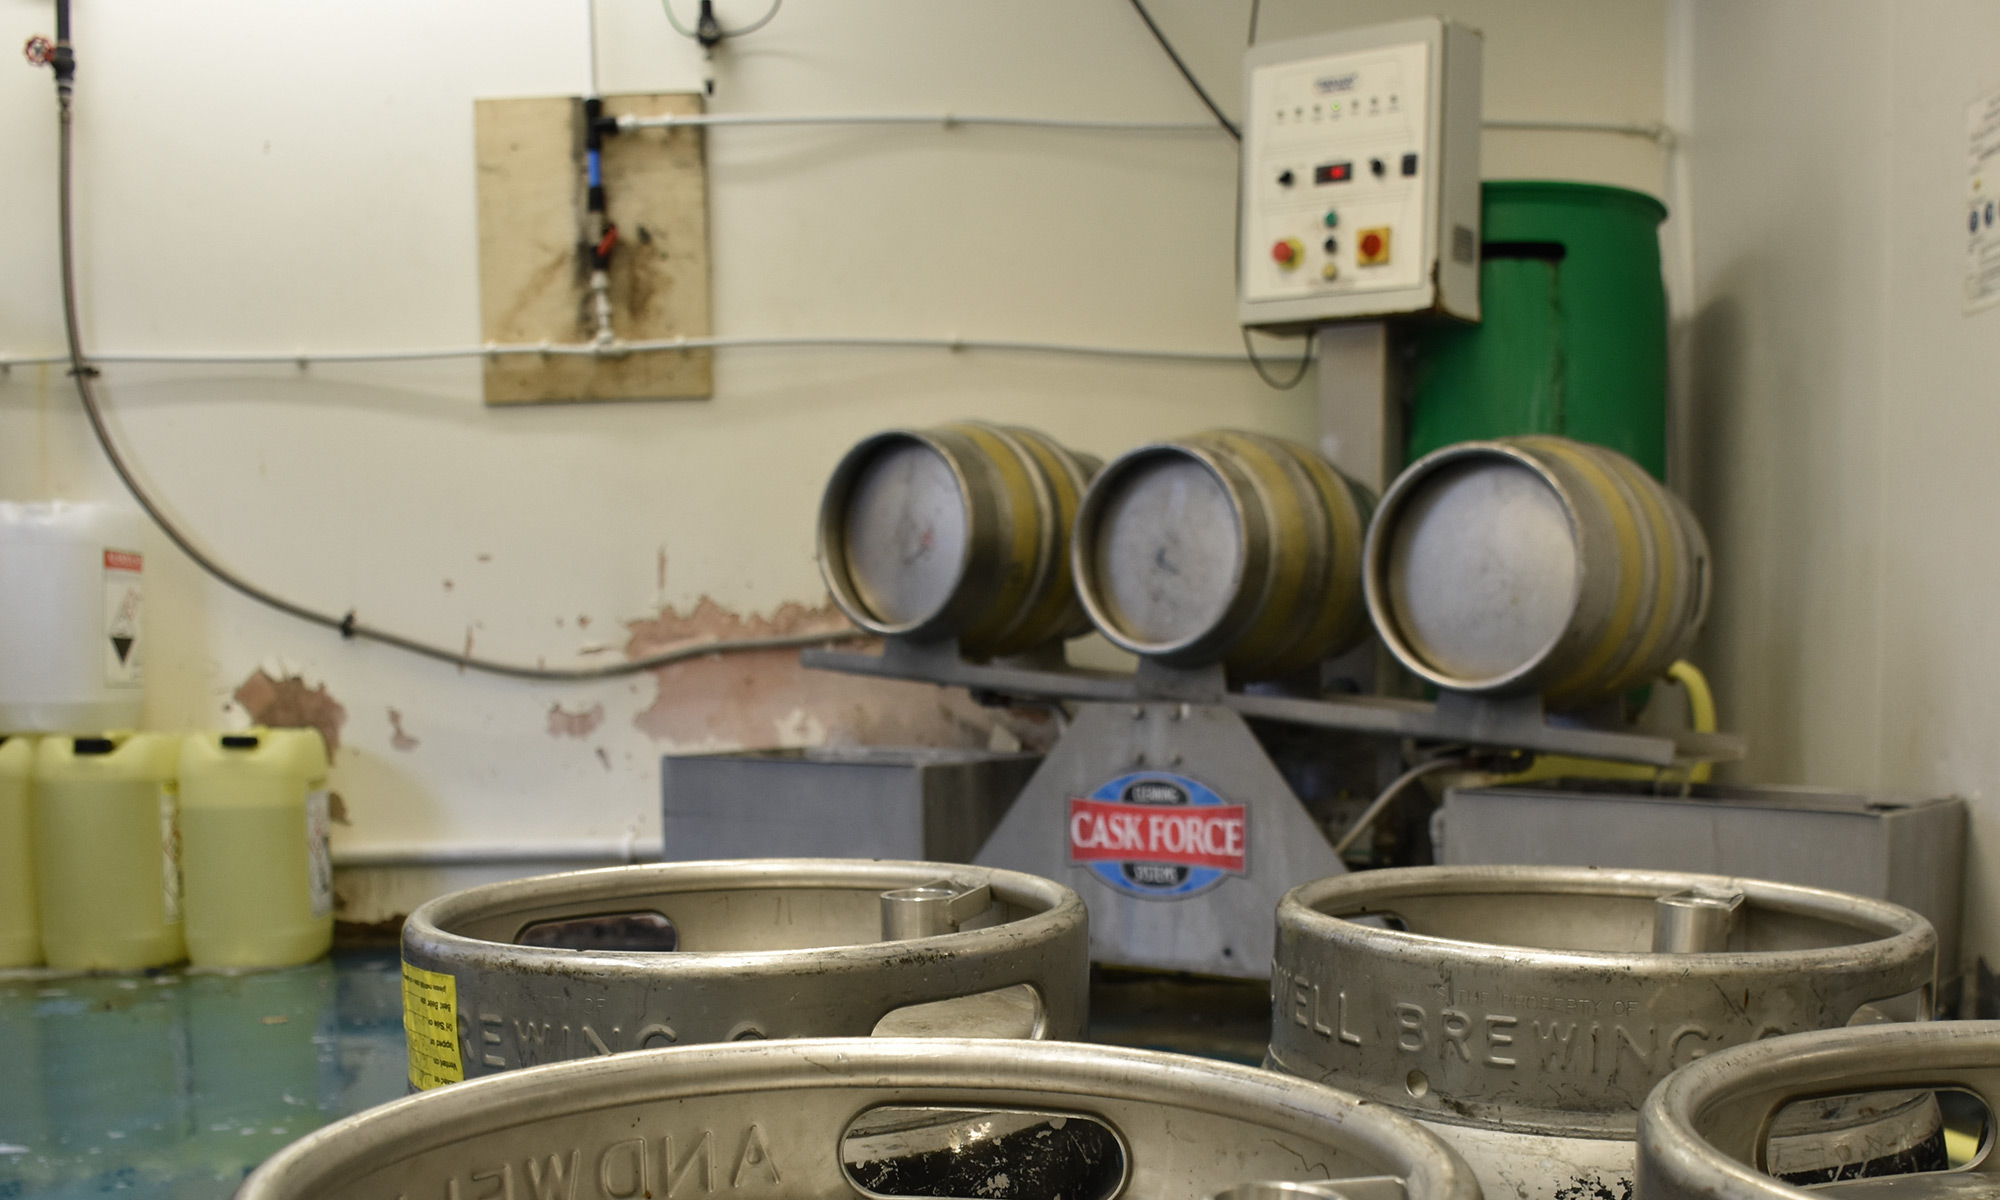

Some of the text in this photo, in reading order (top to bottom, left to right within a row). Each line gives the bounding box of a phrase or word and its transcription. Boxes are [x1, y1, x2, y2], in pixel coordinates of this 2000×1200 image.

[1071, 811, 1244, 857] CASK FORCE
[1271, 958, 1711, 1075] WELL BREWING
[1611, 998, 1639, 1017] OF
[457, 1012, 678, 1070] REWIN
